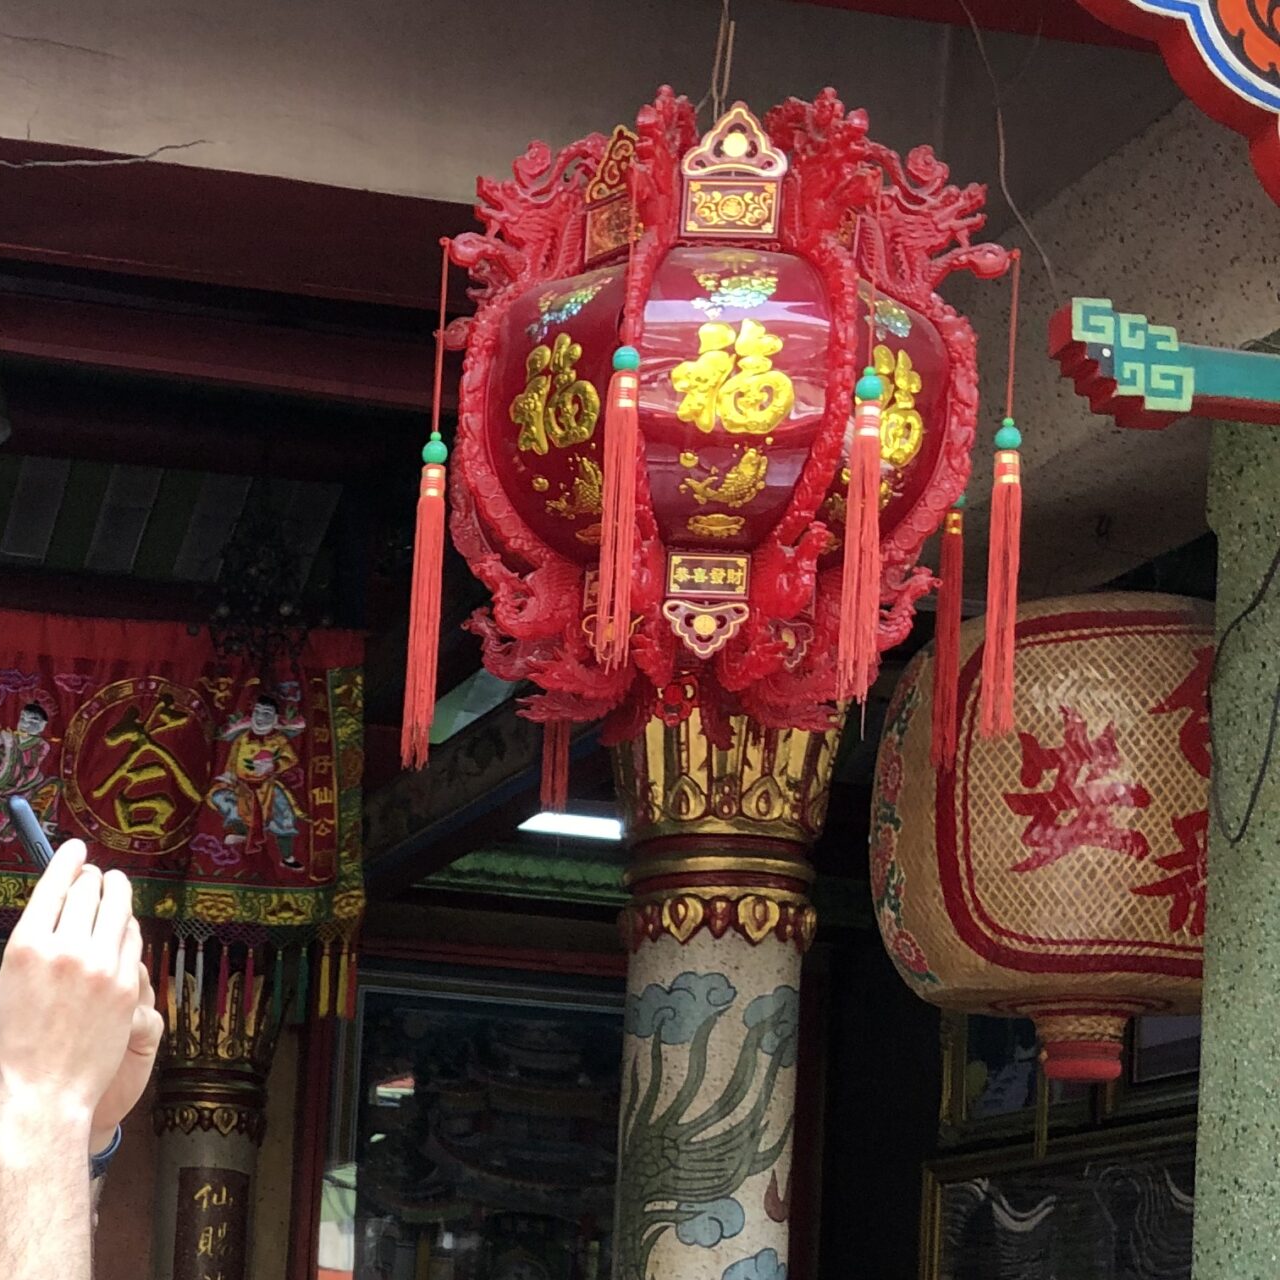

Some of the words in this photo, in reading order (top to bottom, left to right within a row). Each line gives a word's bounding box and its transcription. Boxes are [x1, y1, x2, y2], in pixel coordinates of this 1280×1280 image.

[510, 333, 600, 455] 福
[671, 319, 794, 434] 福
[673, 566, 744, 586] 恭喜發財
